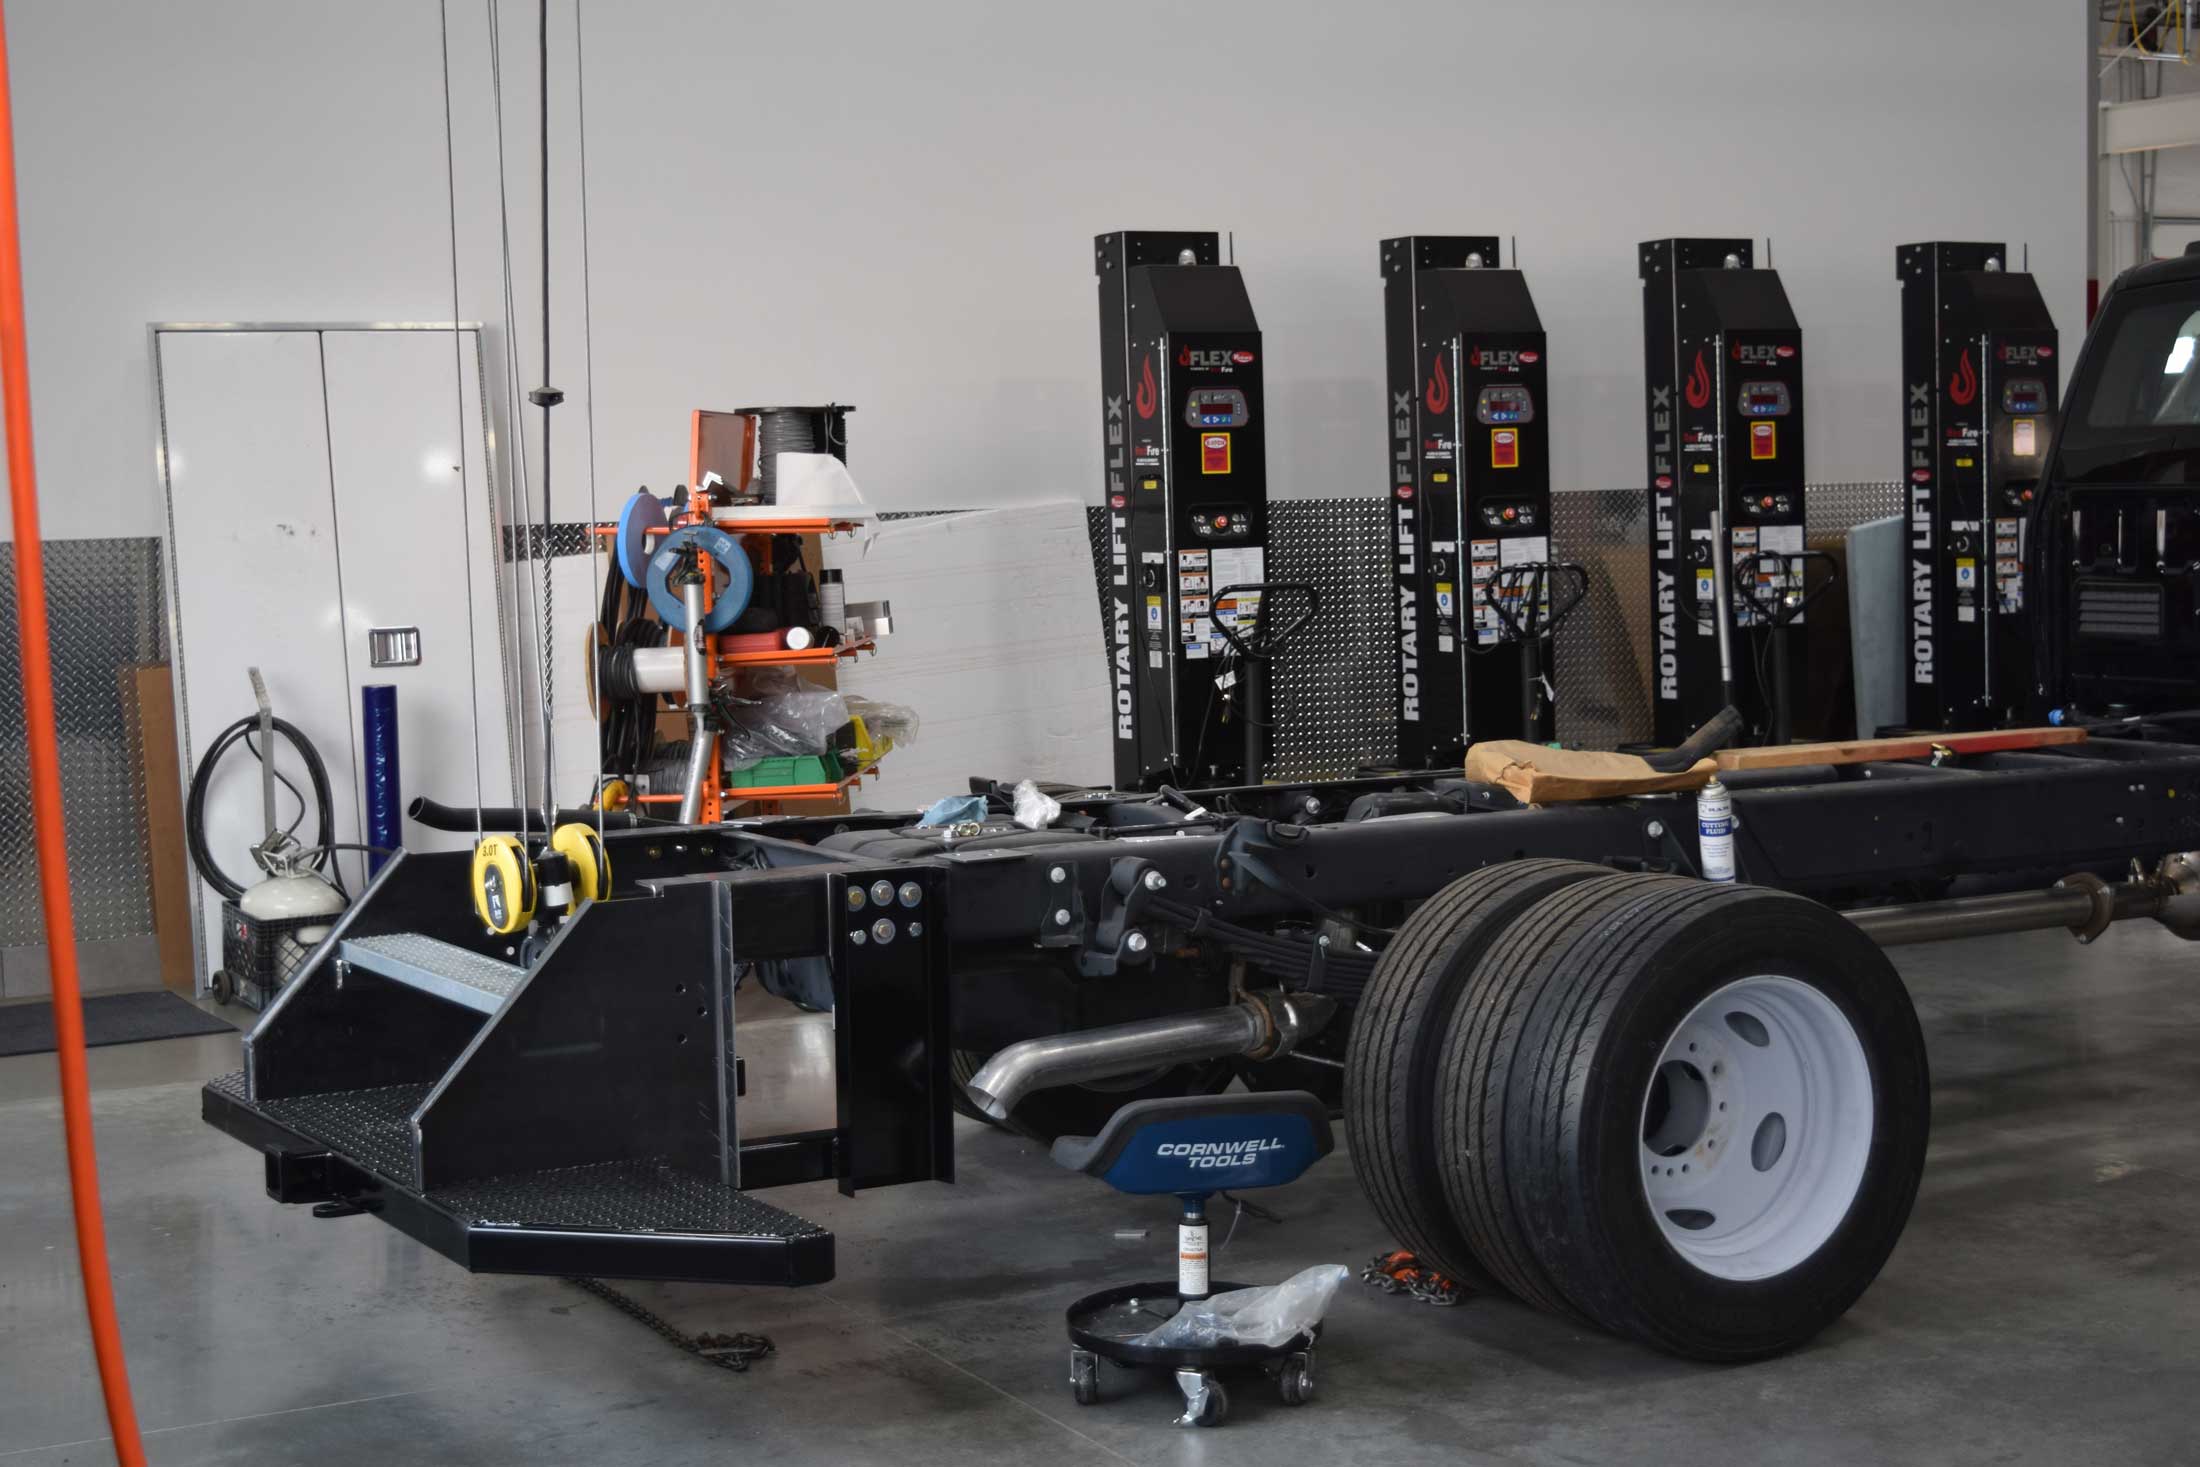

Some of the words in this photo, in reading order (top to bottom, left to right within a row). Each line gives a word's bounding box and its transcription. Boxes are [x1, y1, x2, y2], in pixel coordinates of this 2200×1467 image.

[1190, 350, 1233, 366] FLEX
[1481, 351, 1519, 366] FLEX
[1741, 345, 1777, 359] FLEX
[2006, 346, 2037, 360] FLEX
[1108, 394, 1125, 492] FLEX
[1395, 390, 1412, 483] FLEX
[1653, 385, 1672, 474] FLEX
[1911, 383, 1929, 467] FLEX
[1112, 512, 1128, 585] LIFT
[1398, 504, 1415, 574] LIFT
[1656, 493, 1674, 559] LIFT
[1912, 485, 1931, 549] LIFT
[1400, 585, 1419, 721] ROTARY
[1658, 570, 1678, 700] ROTARY
[1913, 559, 1933, 684] ROTARY
[1114, 596, 1133, 740] ROTARY
[482, 844, 498, 857] 3.0T
[1157, 1137, 1282, 1156] CORNWELL
[1188, 1153, 1257, 1168] TOOLS
